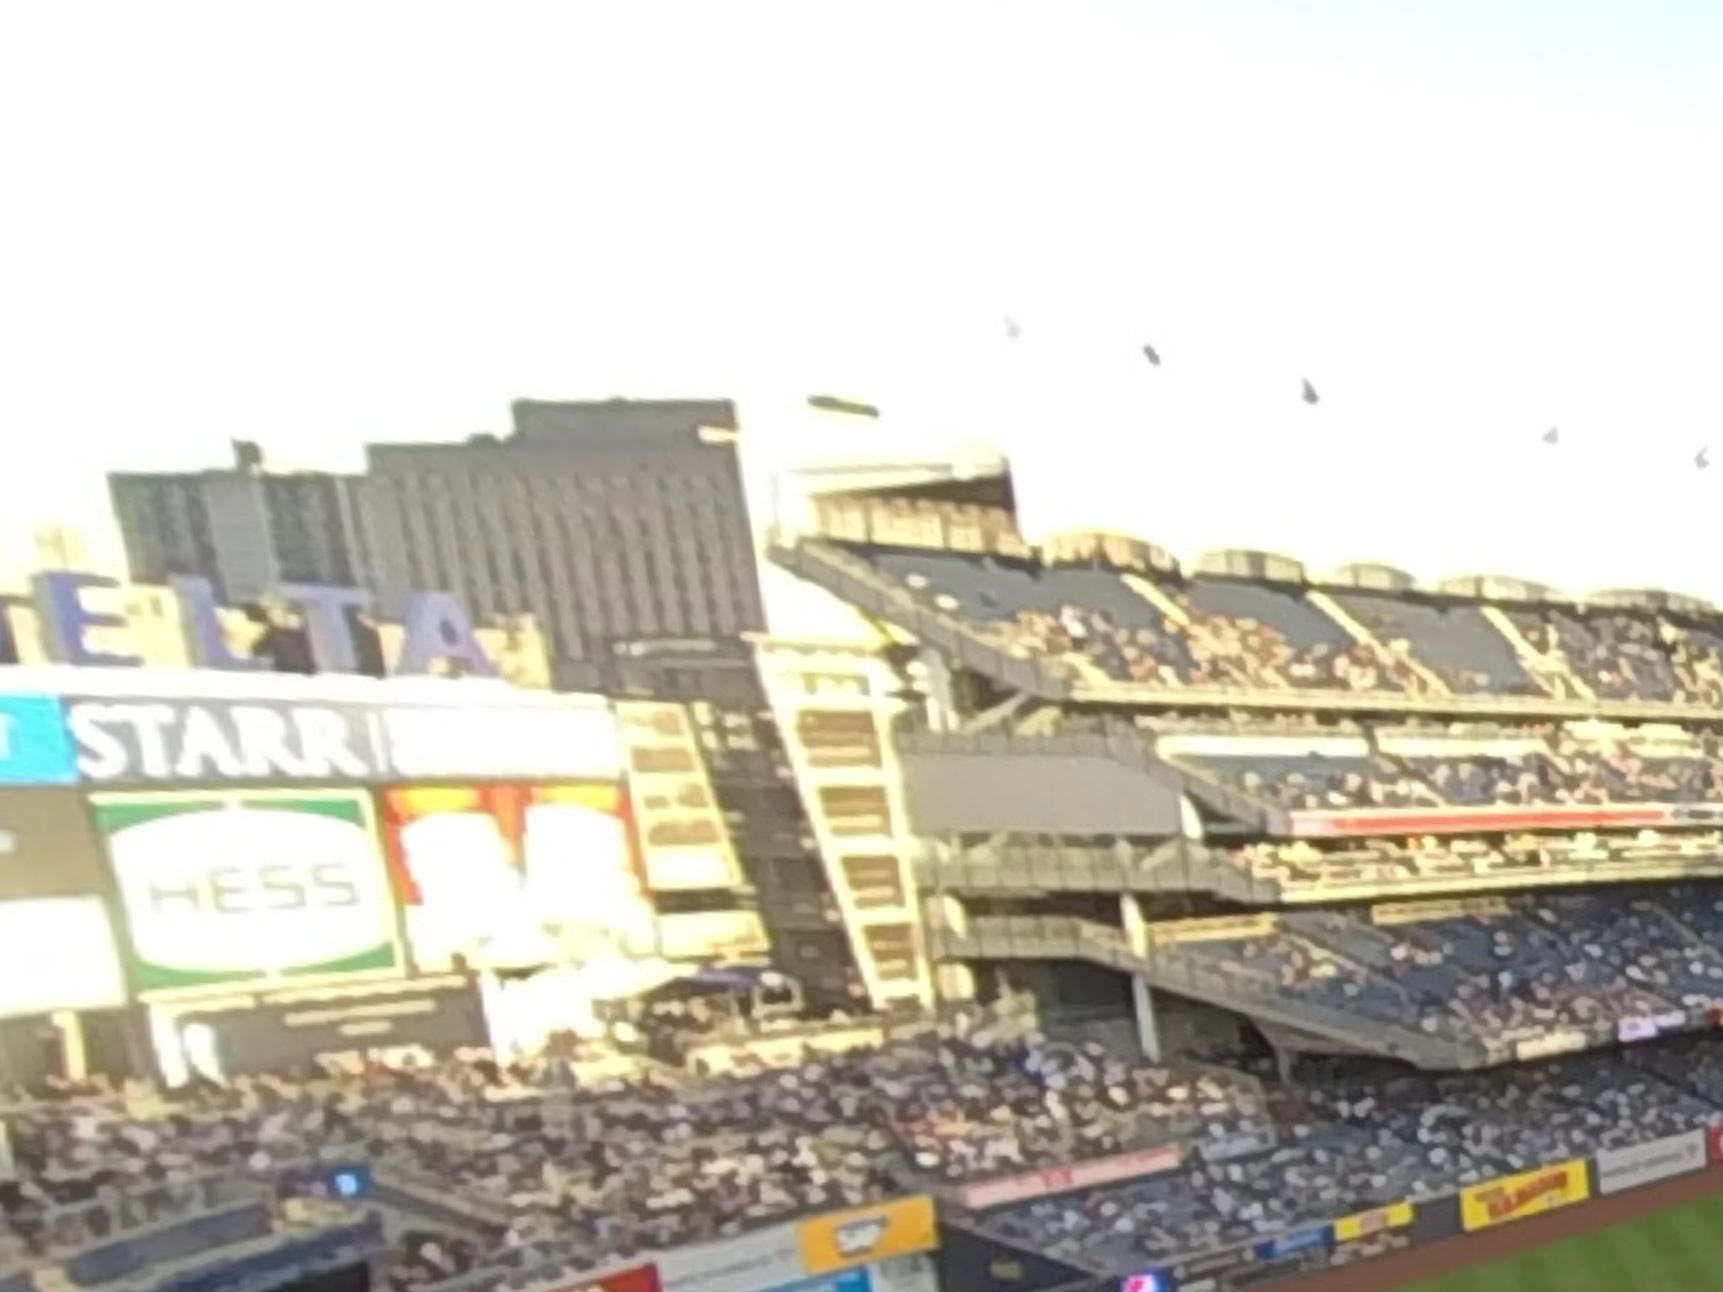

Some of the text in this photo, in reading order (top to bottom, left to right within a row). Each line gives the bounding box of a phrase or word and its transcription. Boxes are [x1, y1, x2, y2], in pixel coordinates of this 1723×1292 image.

[0, 570, 500, 679] ELTA
[69, 702, 370, 780] STARR
[147, 861, 362, 914] HESS
